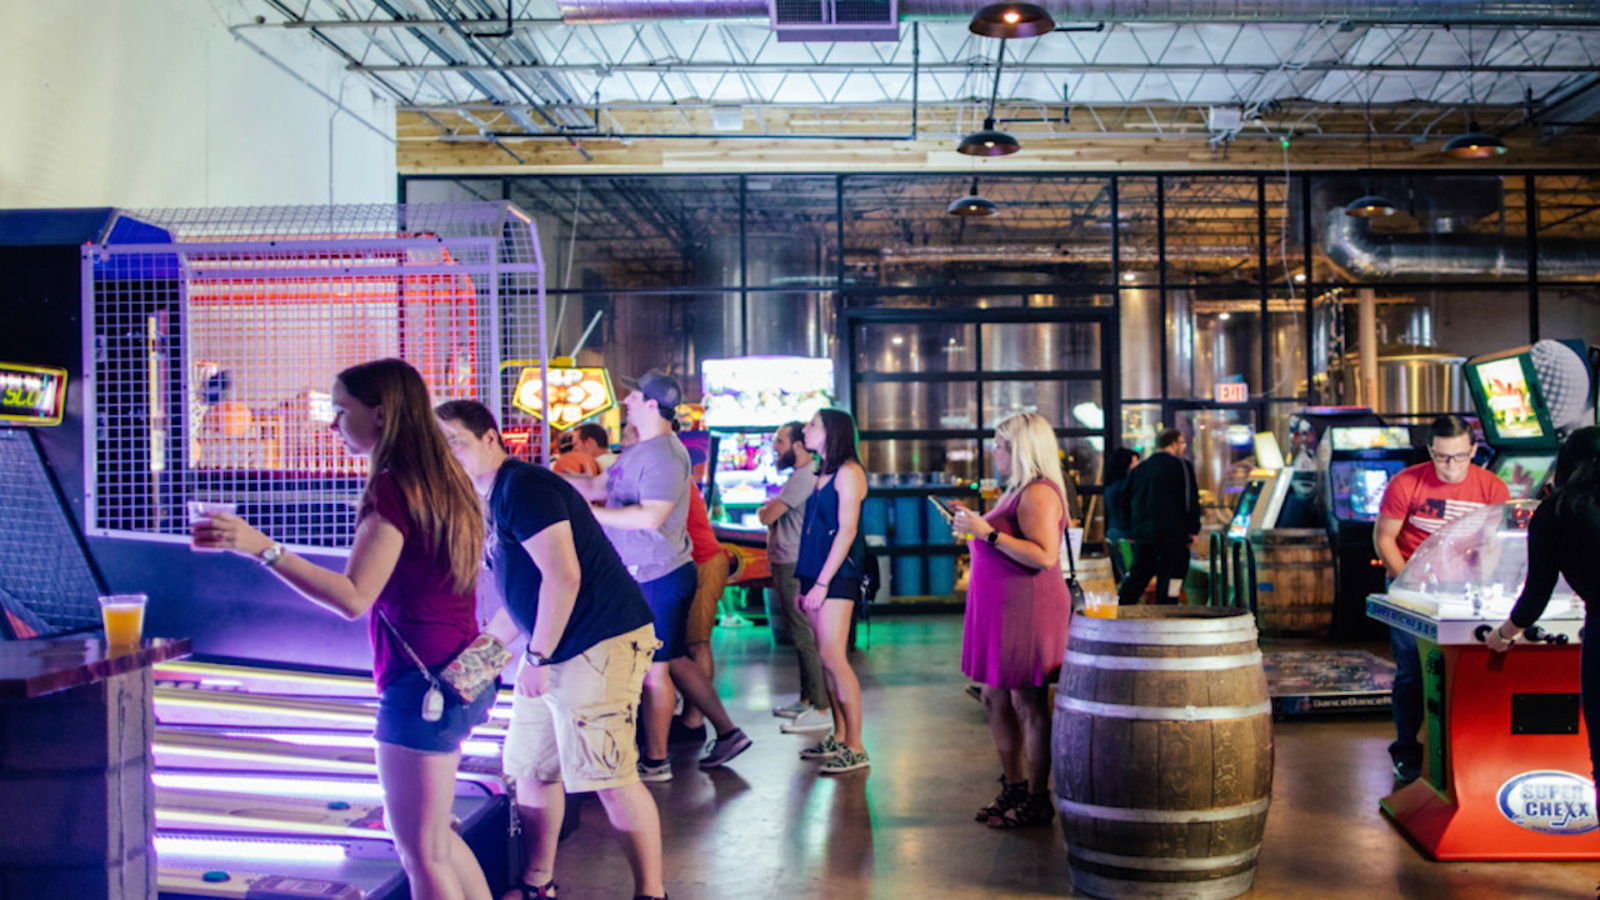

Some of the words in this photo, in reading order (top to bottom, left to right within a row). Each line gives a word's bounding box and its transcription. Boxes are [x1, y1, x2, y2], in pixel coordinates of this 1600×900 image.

[1219, 384, 1244, 401] EXIT
[1522, 784, 1583, 799] SUPER
[1525, 801, 1590, 824] CHEXX
